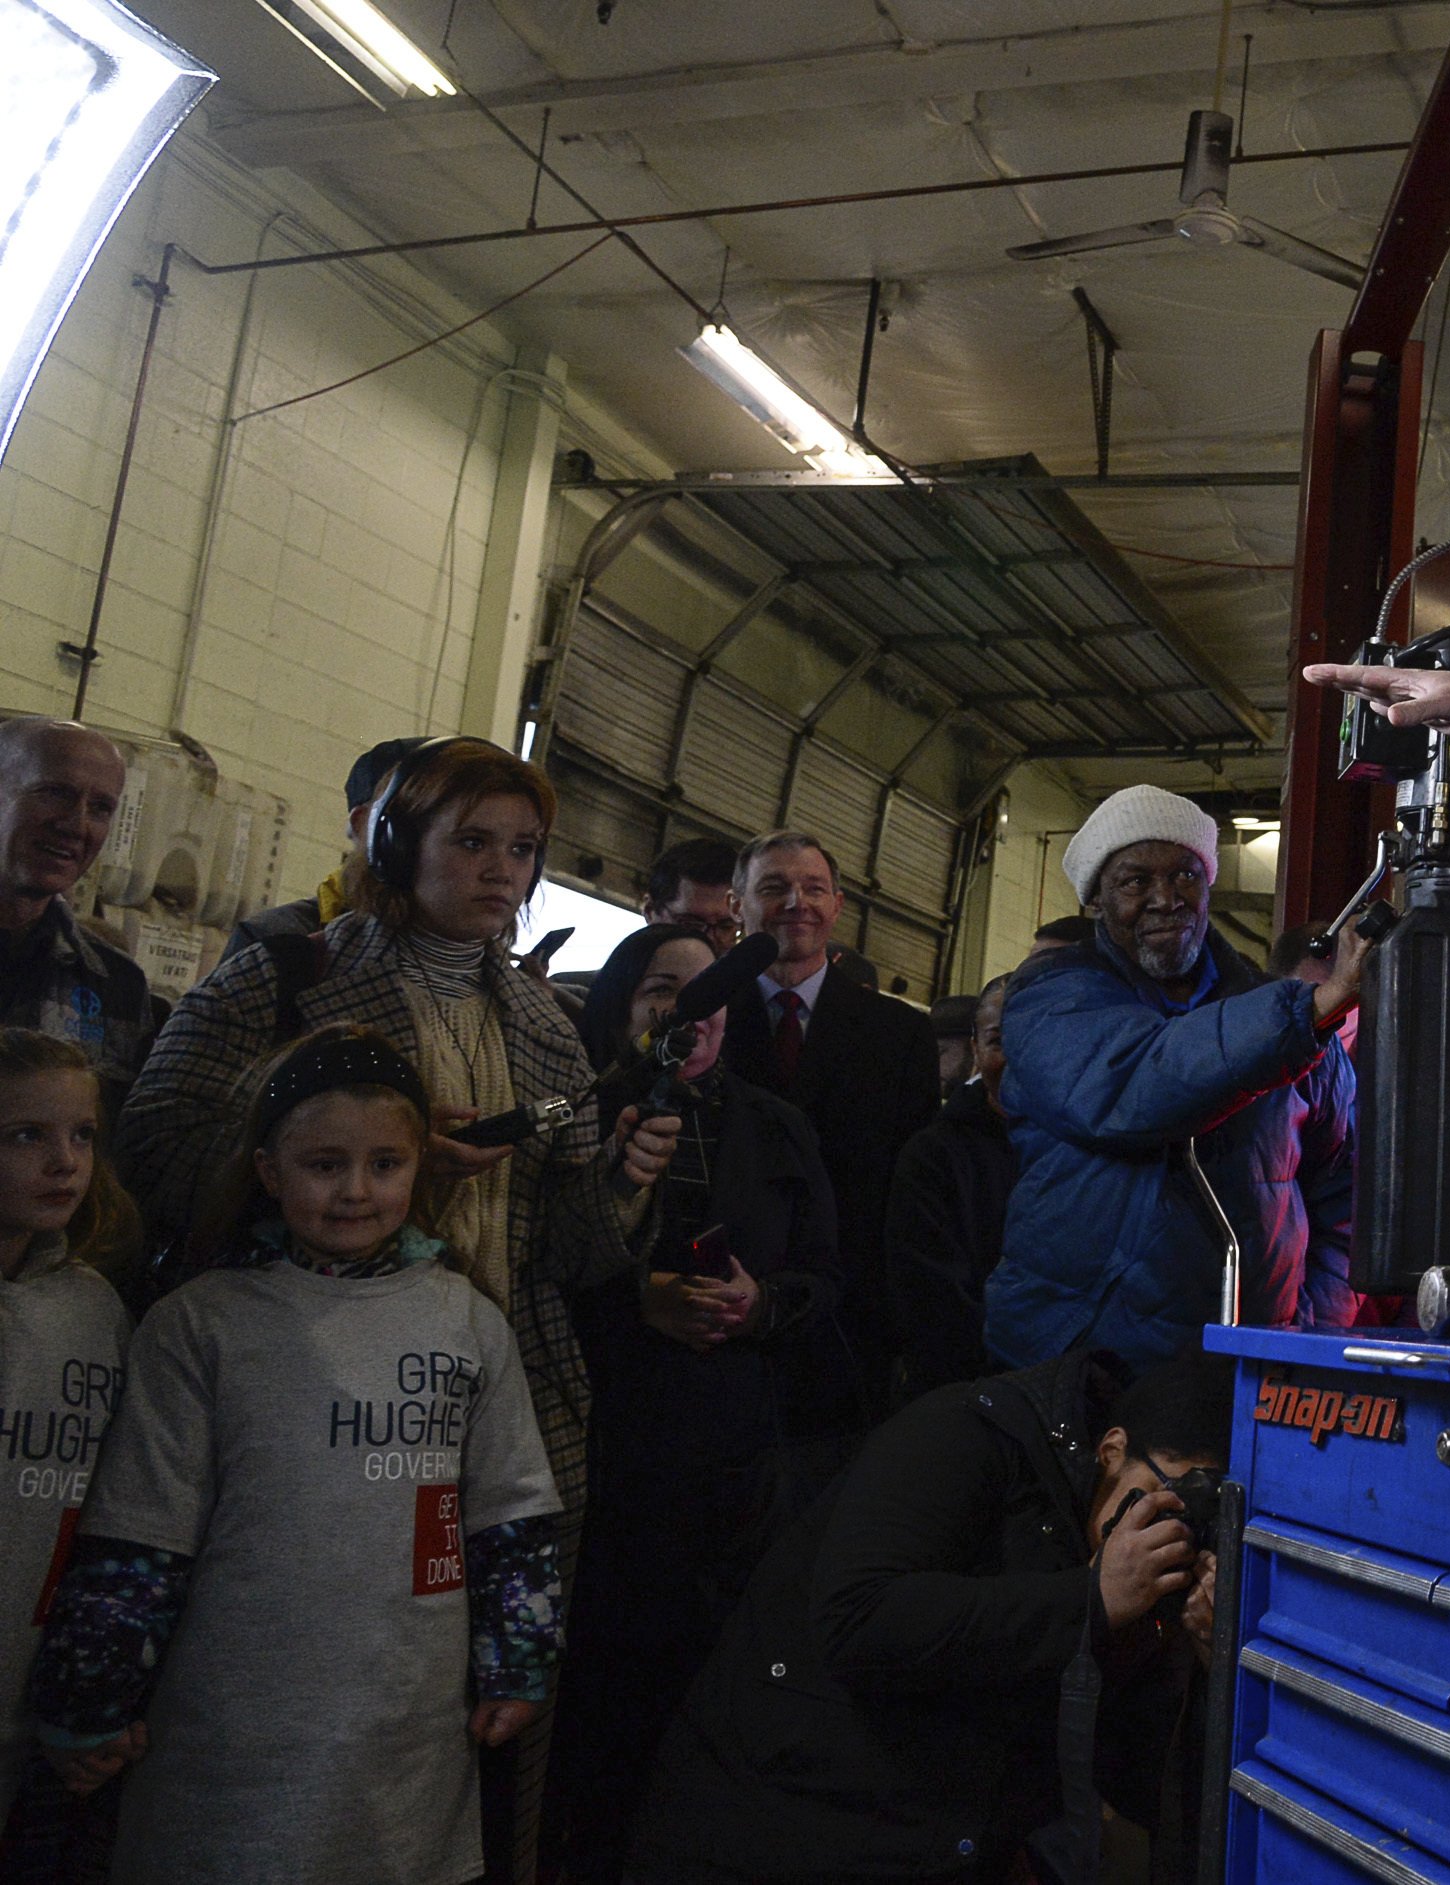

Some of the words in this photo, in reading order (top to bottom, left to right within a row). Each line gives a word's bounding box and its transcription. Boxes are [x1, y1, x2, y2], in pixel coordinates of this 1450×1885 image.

[329, 1400, 471, 1448] HUGHE
[18, 1466, 89, 1502] GOVE
[438, 1492, 459, 1520] GET
[444, 1523, 458, 1551] IT
[427, 1554, 462, 1585] DONE
